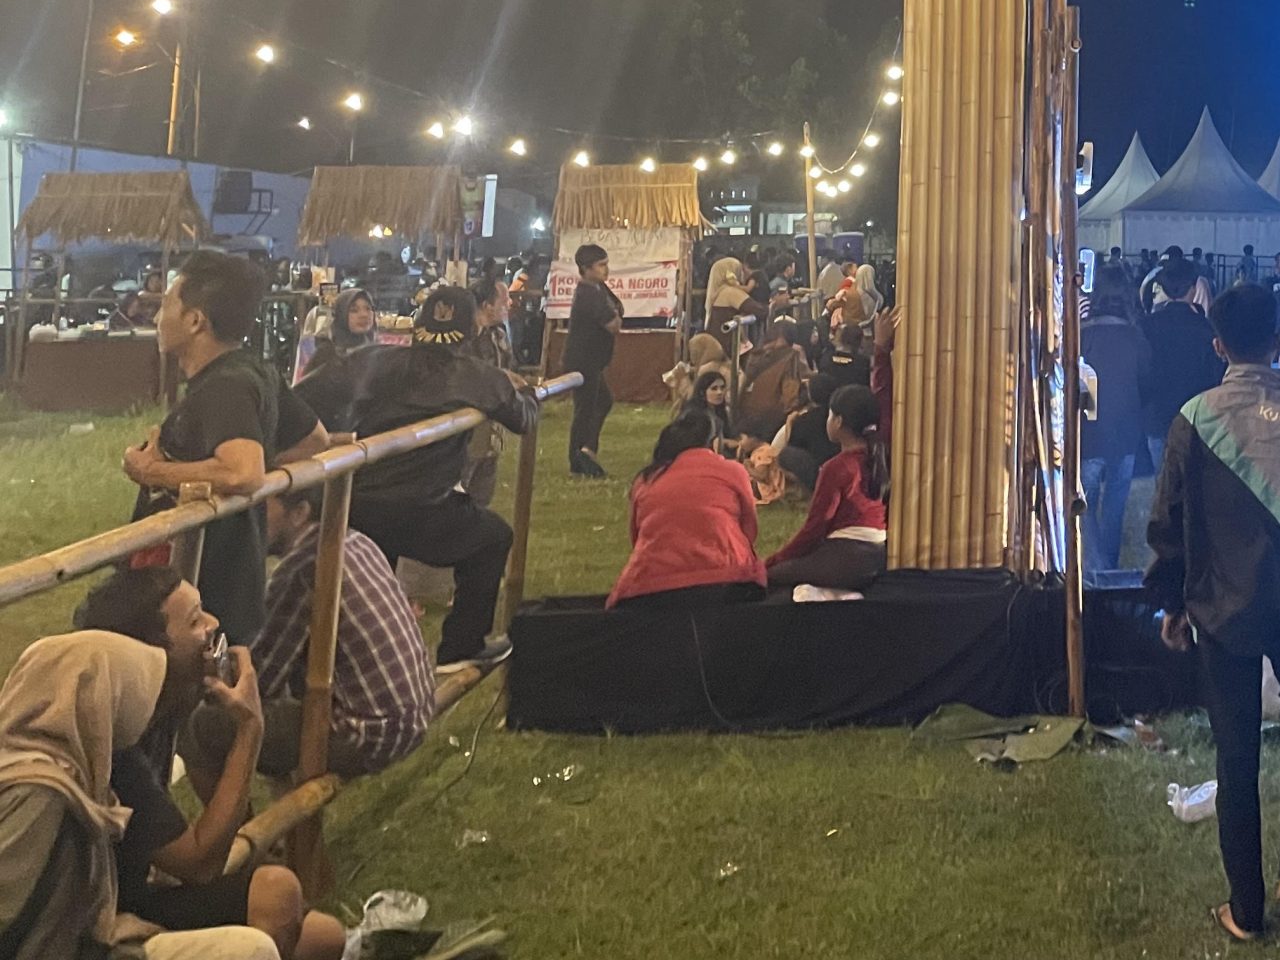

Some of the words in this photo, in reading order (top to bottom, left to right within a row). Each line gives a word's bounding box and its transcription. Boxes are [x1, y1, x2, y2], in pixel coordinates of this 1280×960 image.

[608, 278, 624, 289] SA
[628, 277, 669, 289] NGORO
[557, 287, 573, 296] DE
